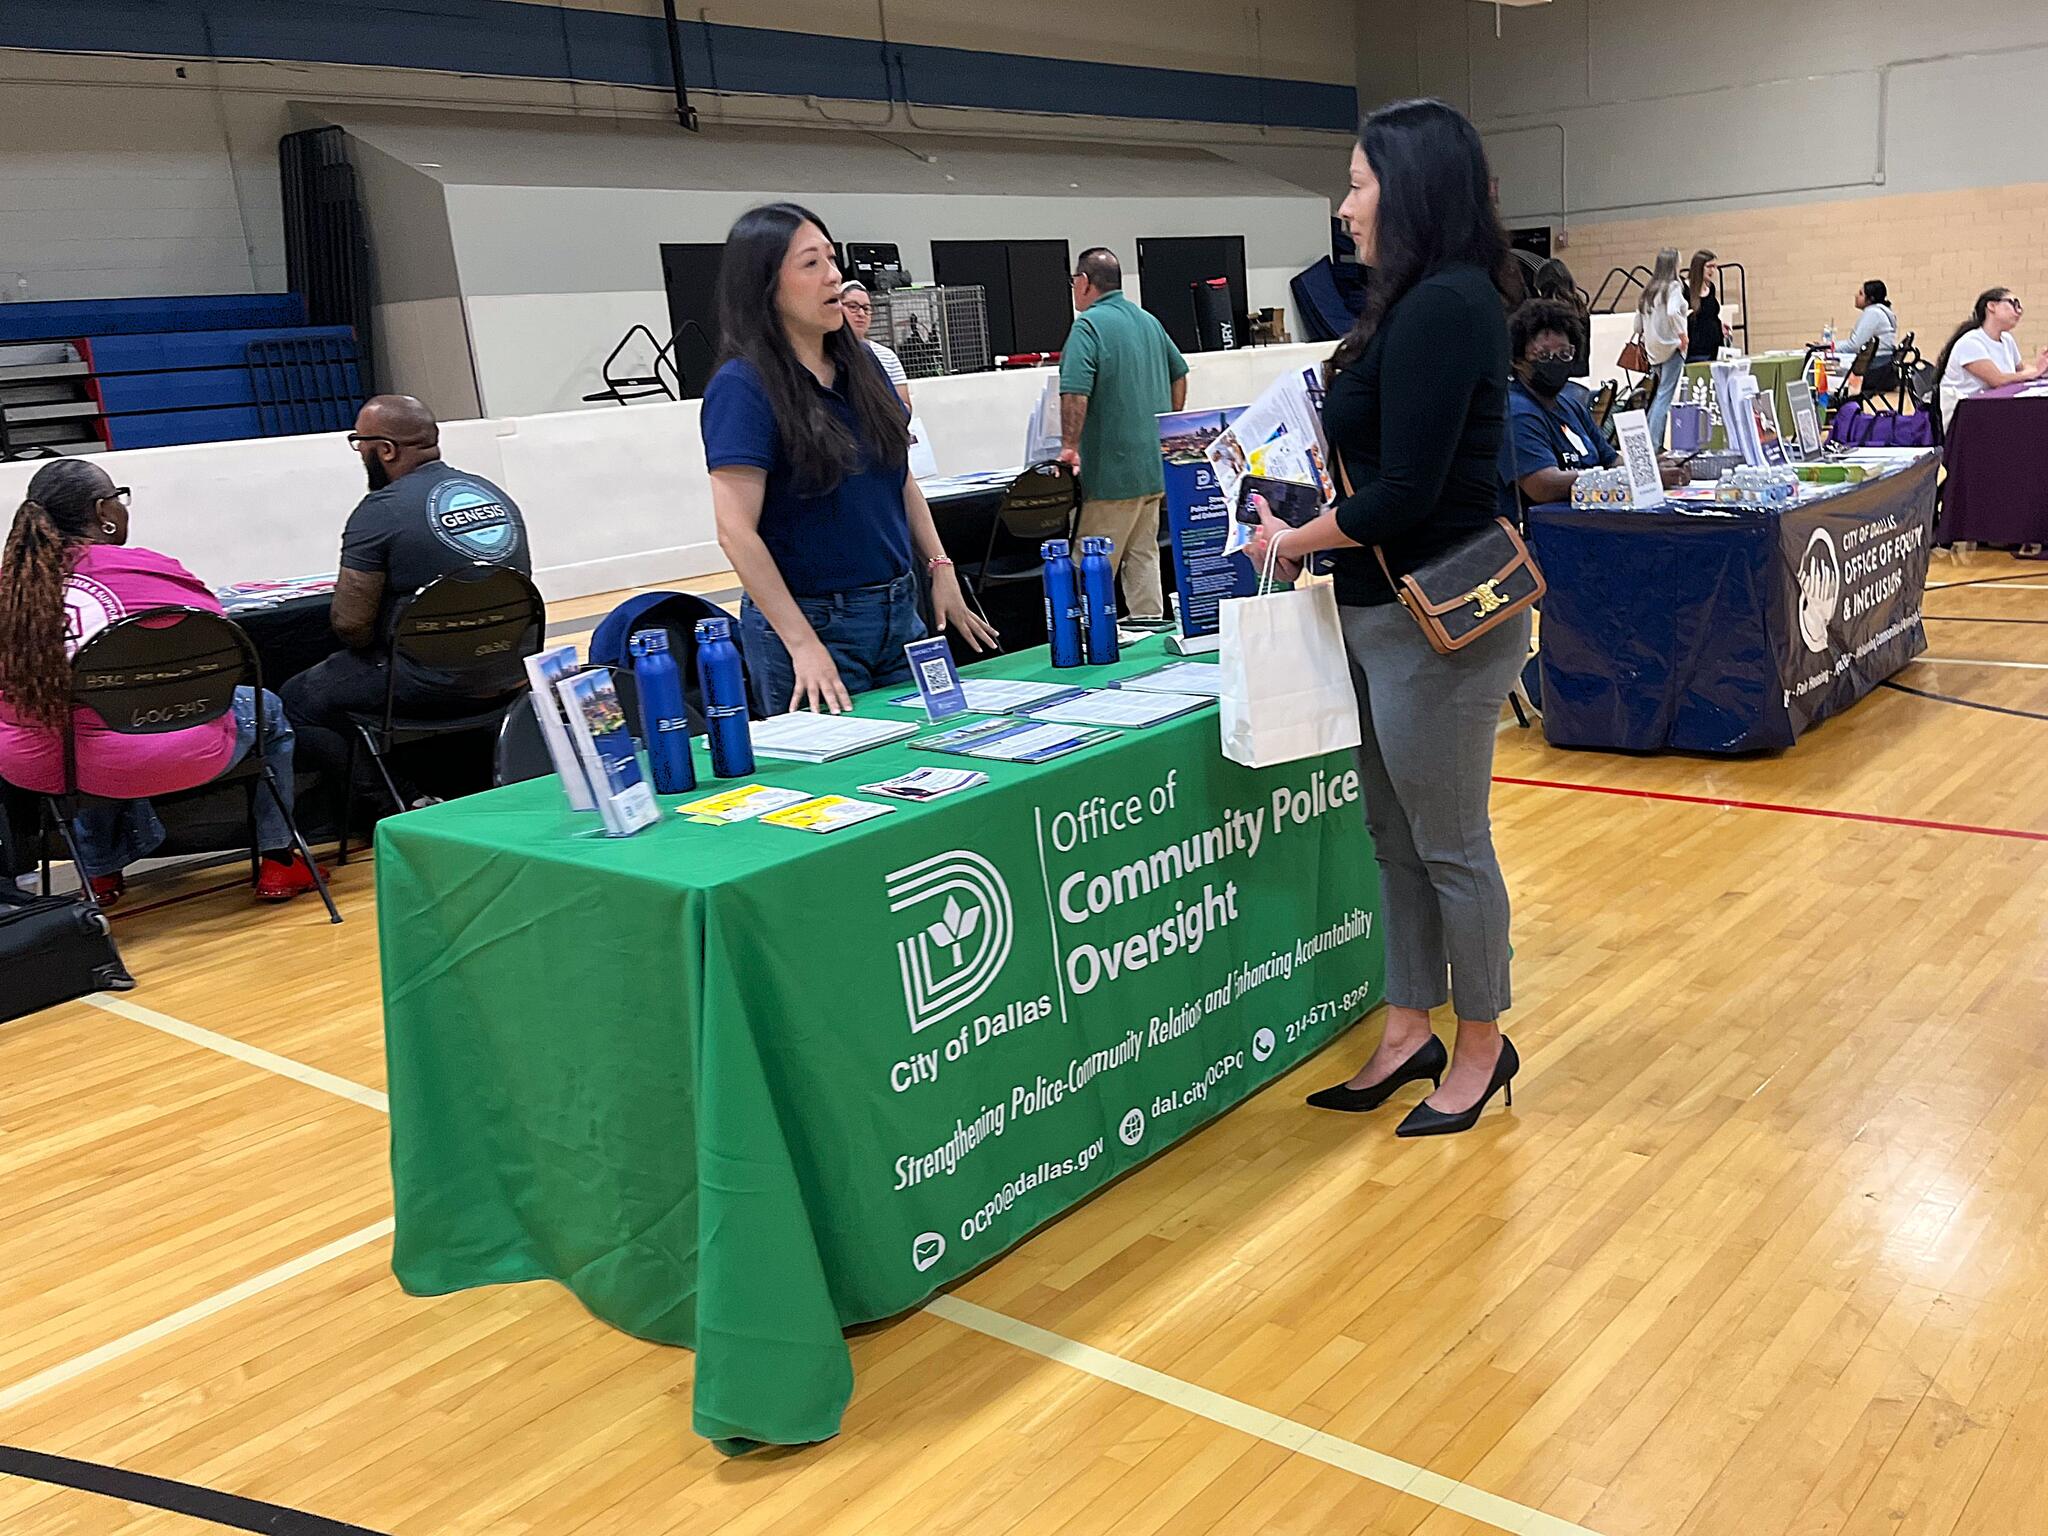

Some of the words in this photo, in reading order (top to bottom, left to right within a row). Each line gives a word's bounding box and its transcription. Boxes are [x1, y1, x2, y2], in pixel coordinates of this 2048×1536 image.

[441, 504, 505, 528] GENESIS
[1843, 528, 1858, 551] CITY
[1859, 524, 1869, 543] OF
[1845, 546, 1878, 585] OFFICE
[1880, 540, 1893, 566] OF
[1843, 597, 1851, 621] &
[1052, 796, 1143, 852] Office
[1150, 769, 1177, 815] of
[1059, 808, 1265, 924] Community
[1272, 769, 1360, 834] Police
[1066, 880, 1239, 995] Oversight
[890, 1049, 938, 1092] City
[945, 1026, 969, 1062] of
[974, 994, 1052, 1046] Dallas
[894, 1102, 1005, 1191] Strengthening
[1011, 1030, 1143, 1120] Police-Community
[1147, 998, 1202, 1048] Relatios
[1205, 973, 1232, 1014] and
